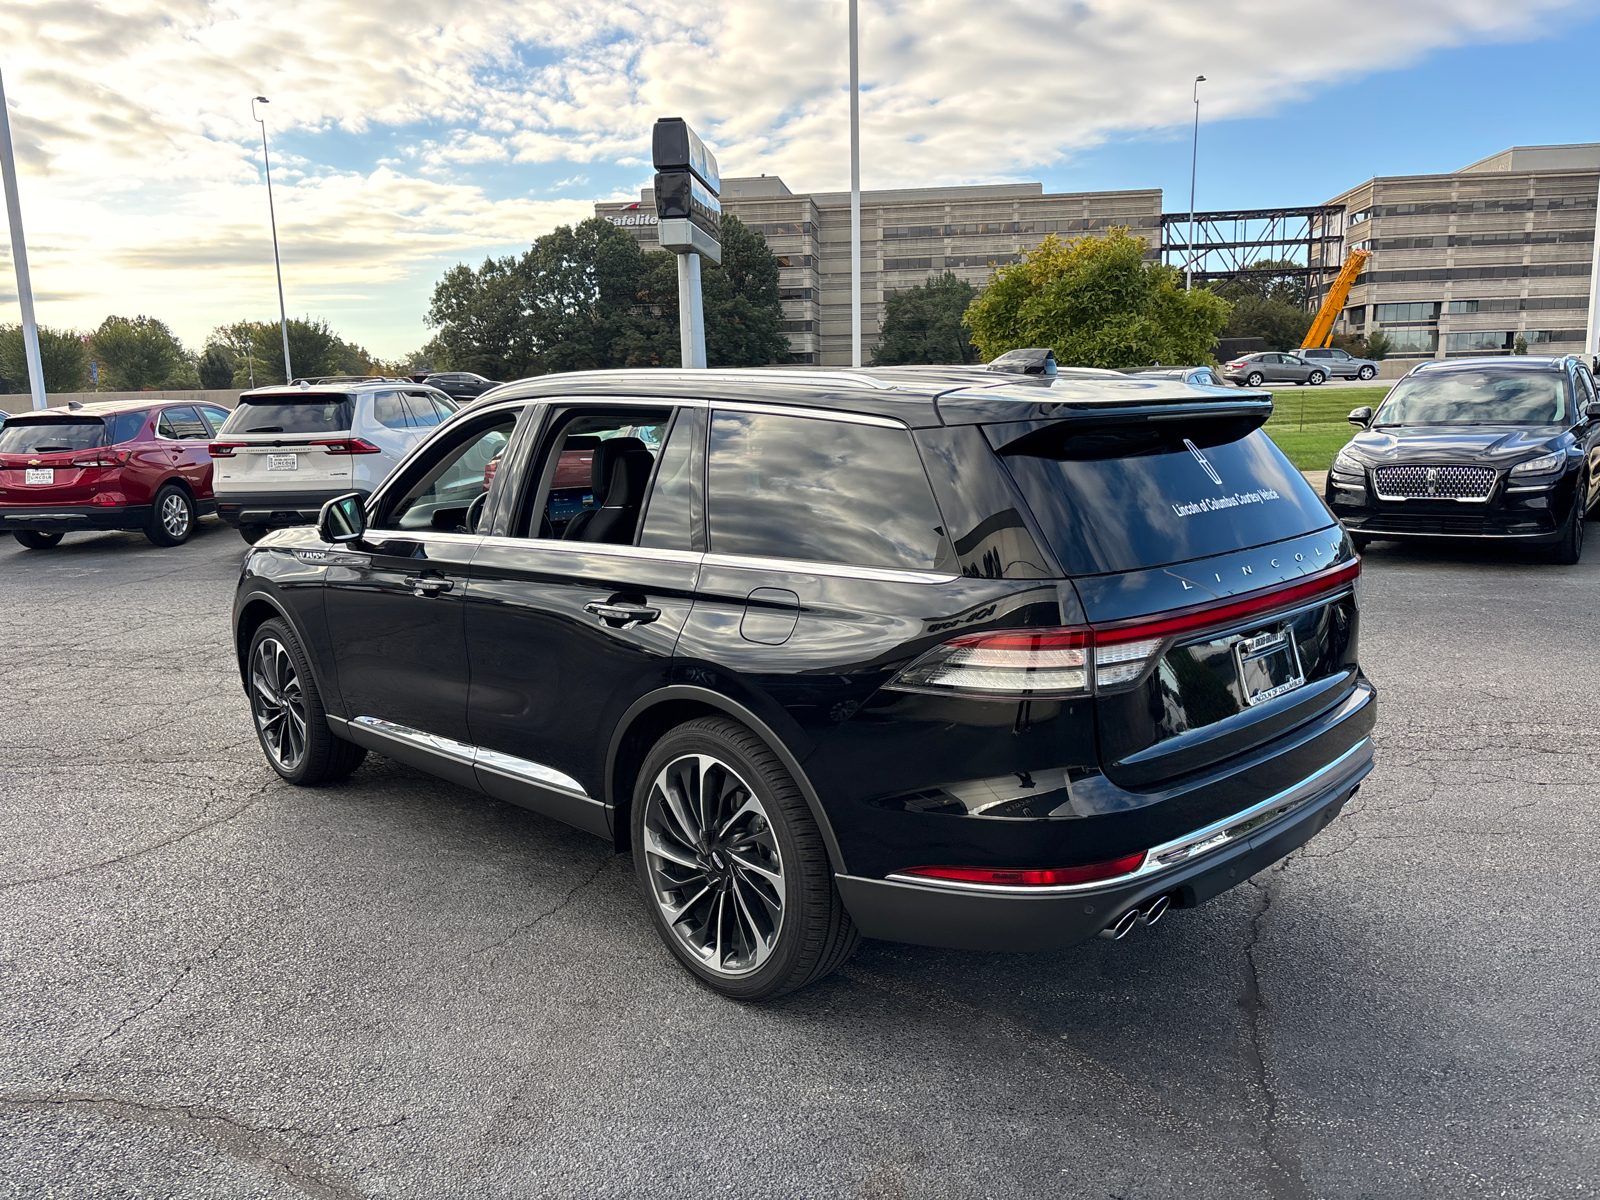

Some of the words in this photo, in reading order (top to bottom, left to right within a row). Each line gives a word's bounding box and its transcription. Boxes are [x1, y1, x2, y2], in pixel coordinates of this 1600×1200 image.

[604, 214, 659, 226] Safelite
[1172, 501, 1202, 517] Lincoln
[1199, 499, 1210, 512] of
[1205, 495, 1239, 511] Columbus
[1234, 492, 1264, 504] Courtesy
[1181, 541, 1339, 590] LINCOLN
[1252, 691, 1272, 705] LINCOLN
[1272, 689, 1279, 697] OF
[1279, 680, 1303, 693] COLUMBUS
